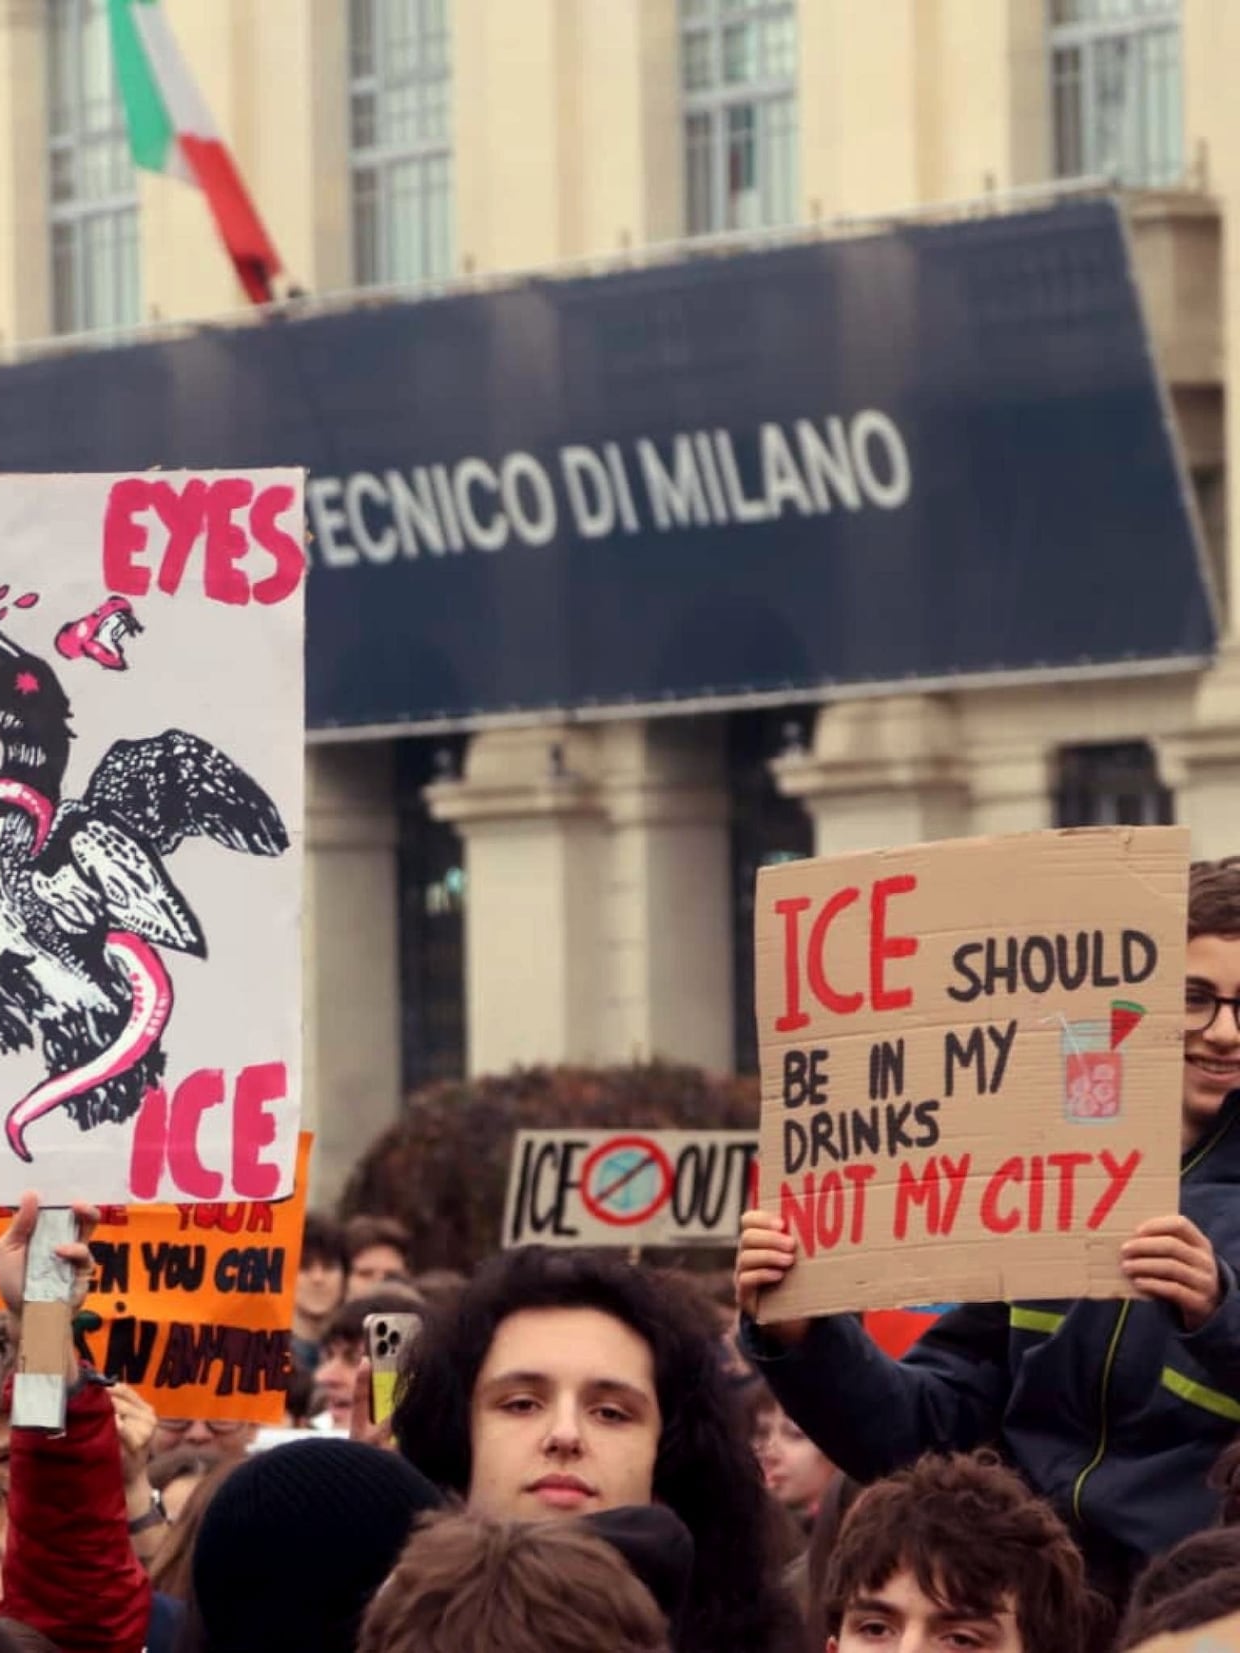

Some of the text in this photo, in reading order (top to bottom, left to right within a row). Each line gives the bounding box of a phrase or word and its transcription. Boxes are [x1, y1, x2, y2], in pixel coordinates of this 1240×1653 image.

[102, 477, 307, 605] EYES
[306, 408, 912, 568] ECNICO DI MILANO
[774, 874, 1157, 1032] ICE SHOULD
[783, 1020, 1017, 1108] BE IN MY
[129, 1062, 287, 1199] ICE
[784, 1100, 940, 1175] DRINKS
[513, 1140, 589, 1241] ICE
[780, 1149, 1142, 1258] NOT MY CITY
[141, 1241, 206, 1292] YOU
[214, 1247, 286, 1294] CAN
